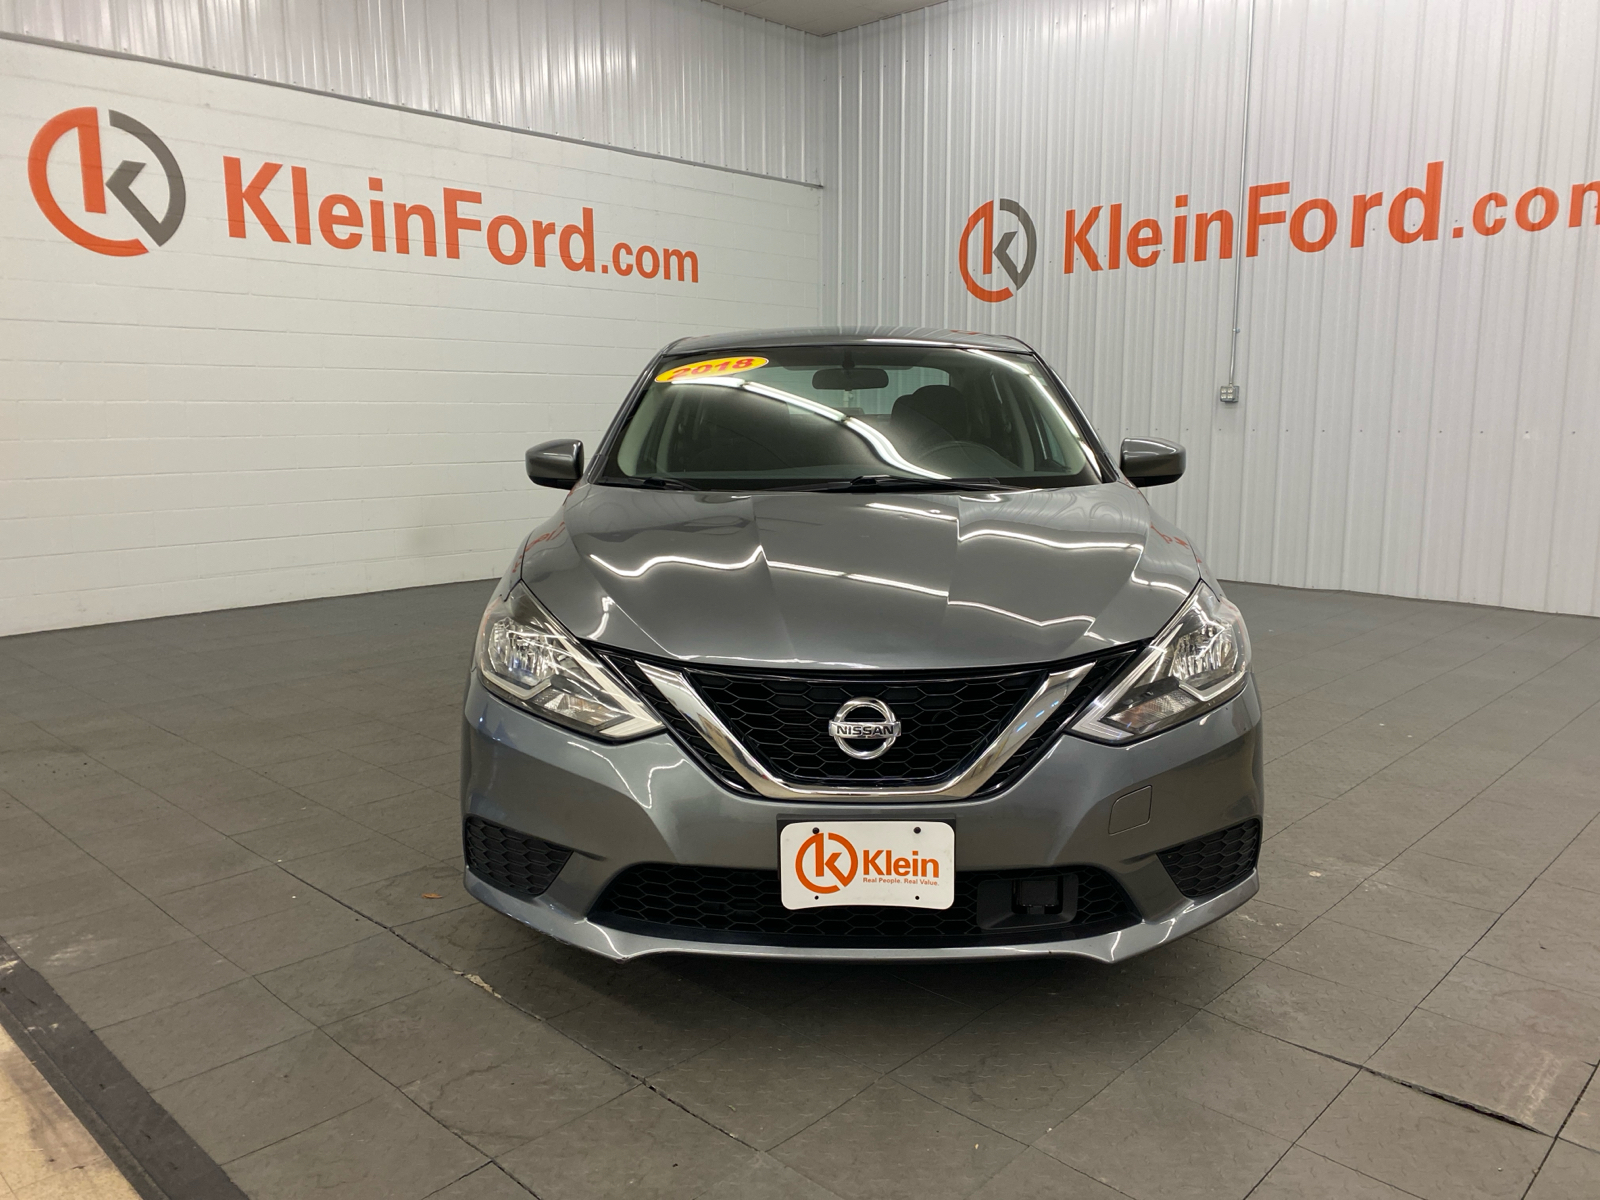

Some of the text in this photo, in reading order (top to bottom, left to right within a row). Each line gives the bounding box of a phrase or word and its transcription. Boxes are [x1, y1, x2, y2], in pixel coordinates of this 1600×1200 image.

[222, 155, 699, 283] KleinFord.com
[667, 358, 755, 380] 2018
[836, 725, 894, 735] NISSAN
[862, 849, 940, 878] Klein
[878, 877, 902, 885] People.
[903, 877, 918, 885] Real
